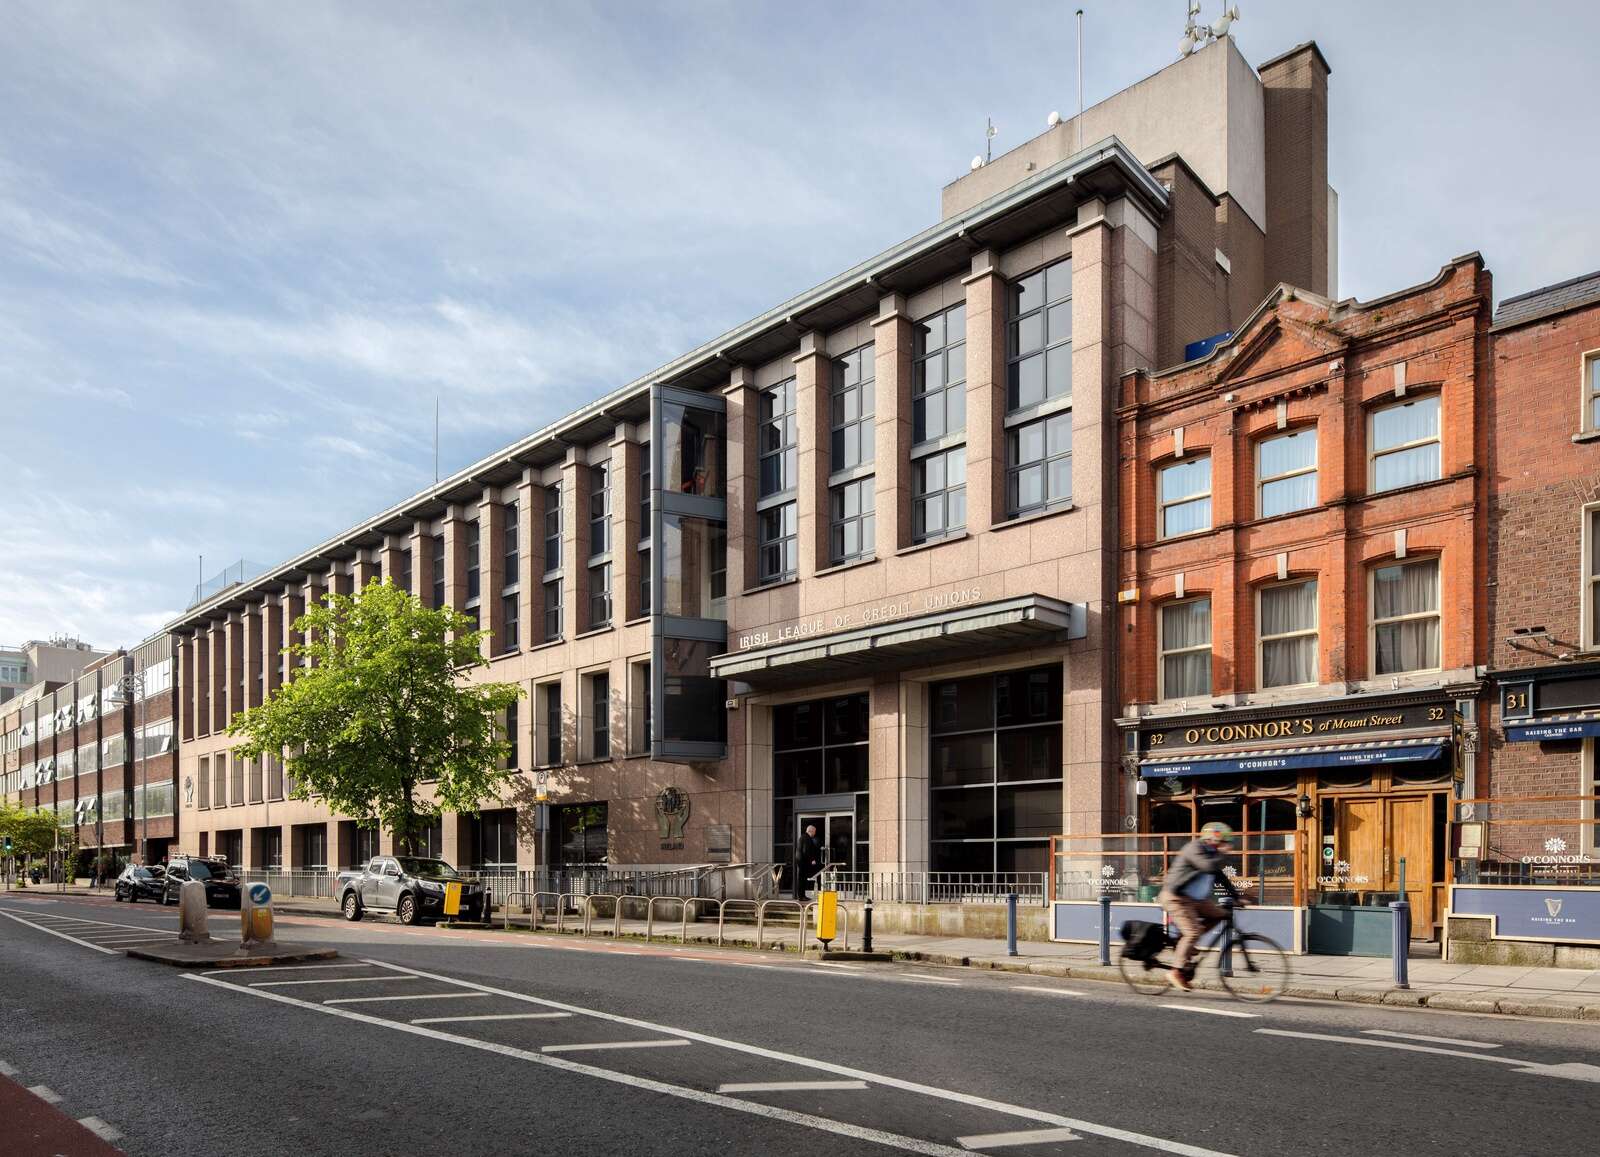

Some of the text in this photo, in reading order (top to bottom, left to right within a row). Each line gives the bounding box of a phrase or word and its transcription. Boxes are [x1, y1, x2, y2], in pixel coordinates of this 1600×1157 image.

[739, 587, 982, 649] IRISH LEAGUE OF CREDIT UNIONS
[1506, 693, 1526, 709] 31
[1428, 707, 1444, 721] 32
[1185, 714, 1403, 744] O'CONNOR'S of Mount Street
[1525, 728, 1552, 736] RAISING
[1151, 733, 1164, 745] 32
[1239, 759, 1286, 769] O'CONNOR'S
[1521, 855, 1591, 864] O'CONNORS
